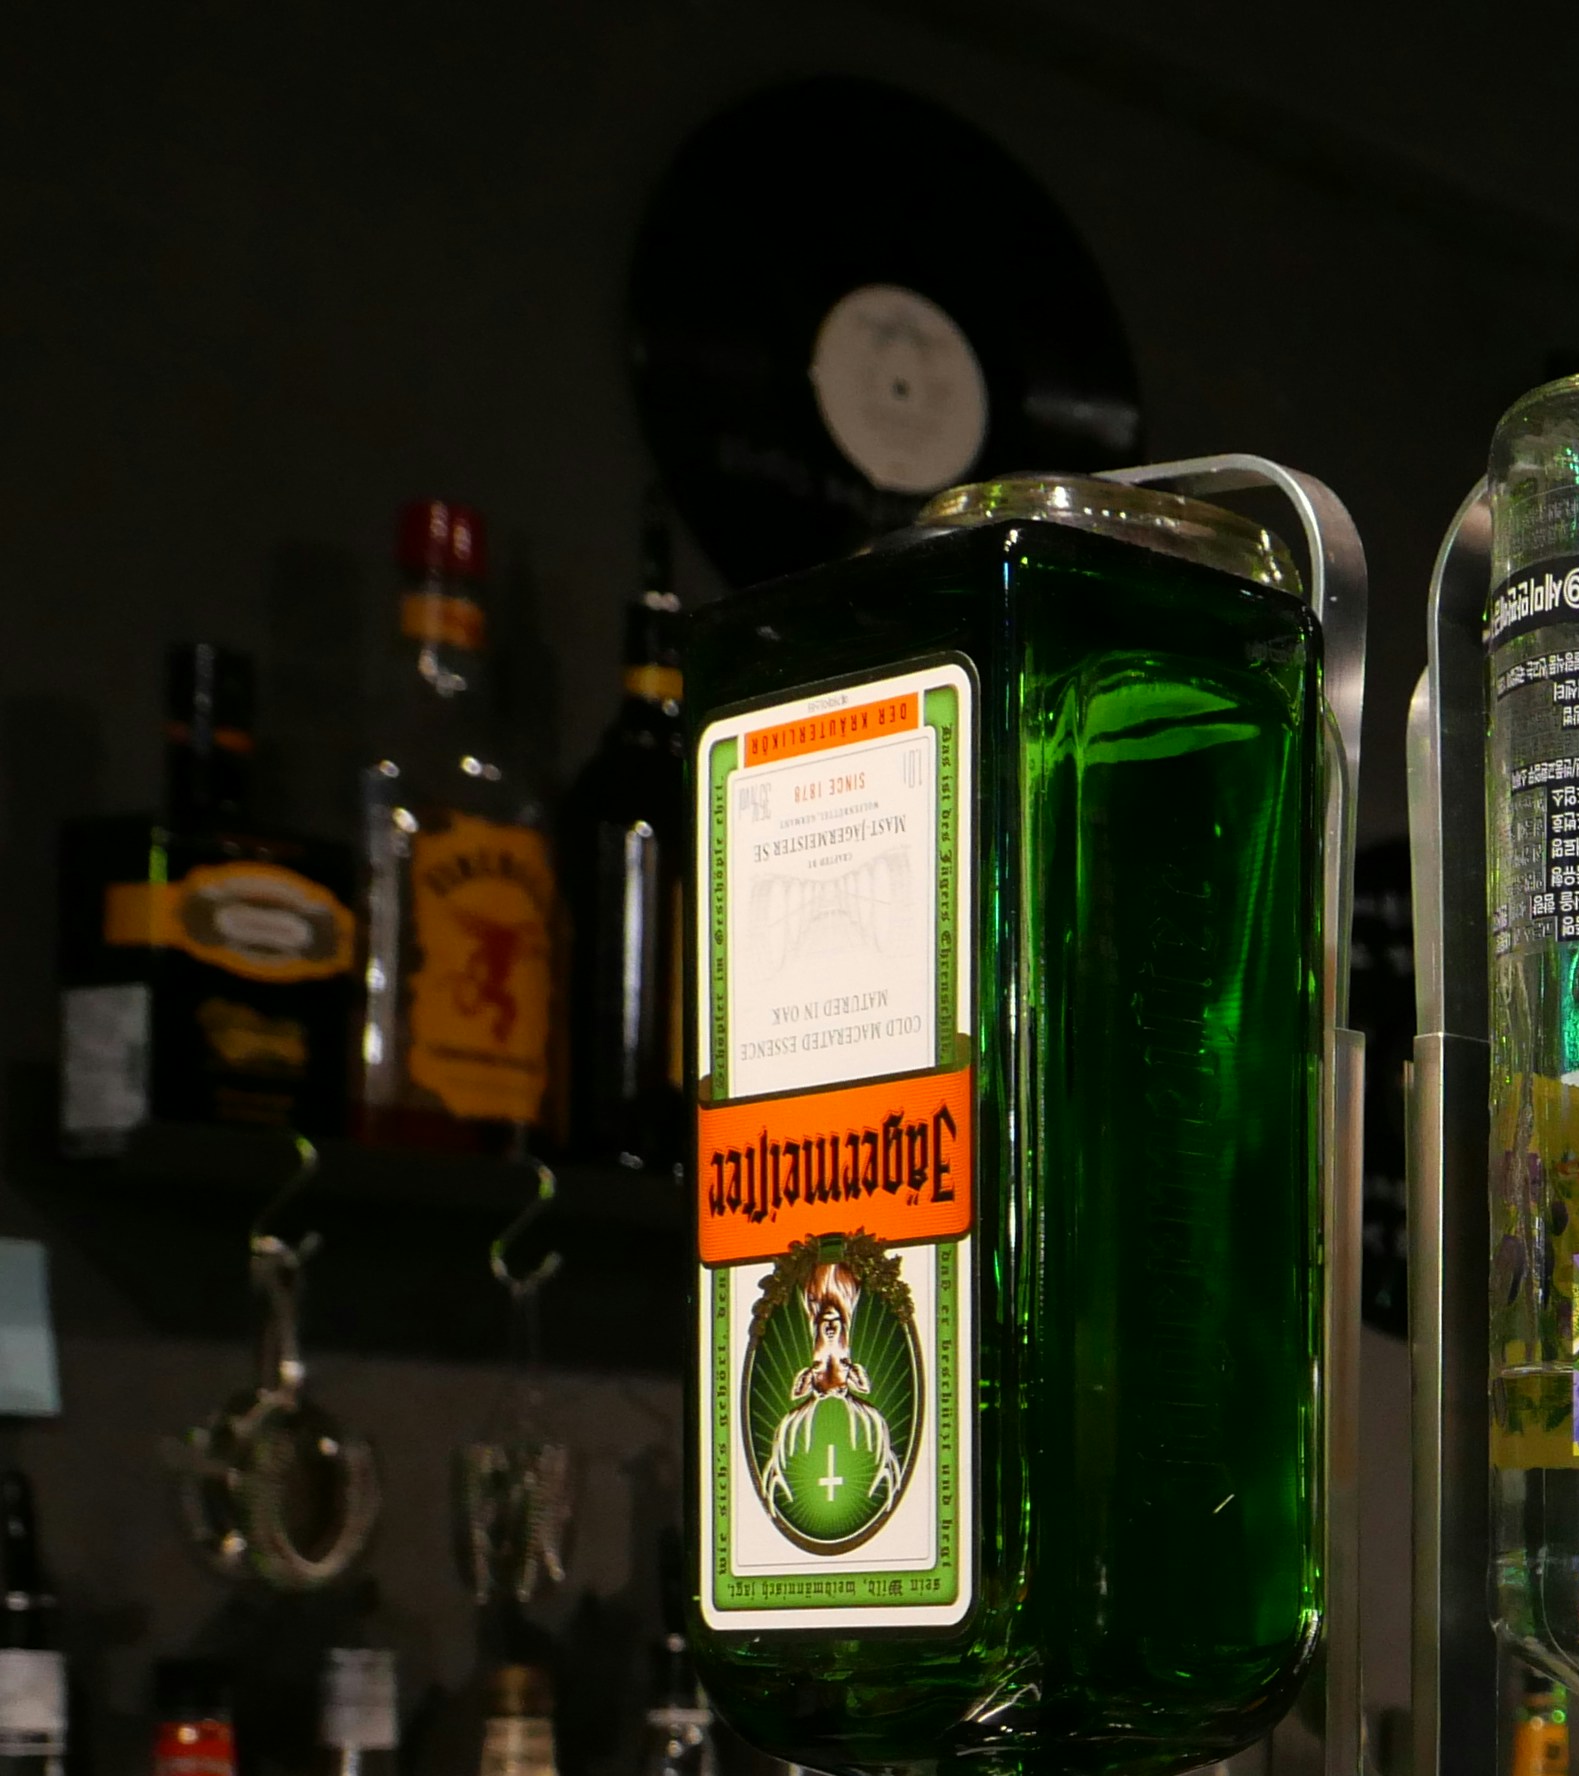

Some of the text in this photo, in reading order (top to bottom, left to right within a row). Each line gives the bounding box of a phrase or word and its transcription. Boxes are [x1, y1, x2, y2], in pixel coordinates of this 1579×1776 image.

[750, 711, 868, 756] KRÄUTERLIKÖR
[877, 703, 907, 726] DER
[940, 722, 954, 767] Das
[793, 772, 865, 803] SINCE 1878
[940, 775, 953, 801] ist
[753, 814, 907, 859] MAST-JÄGERMEISTER SE
[940, 808, 953, 842] des
[939, 849, 954, 923] Jägers
[714, 956, 726, 981] im
[771, 989, 889, 1026] MATURED IN OAK
[739, 1014, 922, 1061] COLD MACERATED ESSENCE
[709, 1105, 957, 1222] Jägermeister
[940, 1464, 953, 1506] und
[910, 1577, 942, 1593] sein
